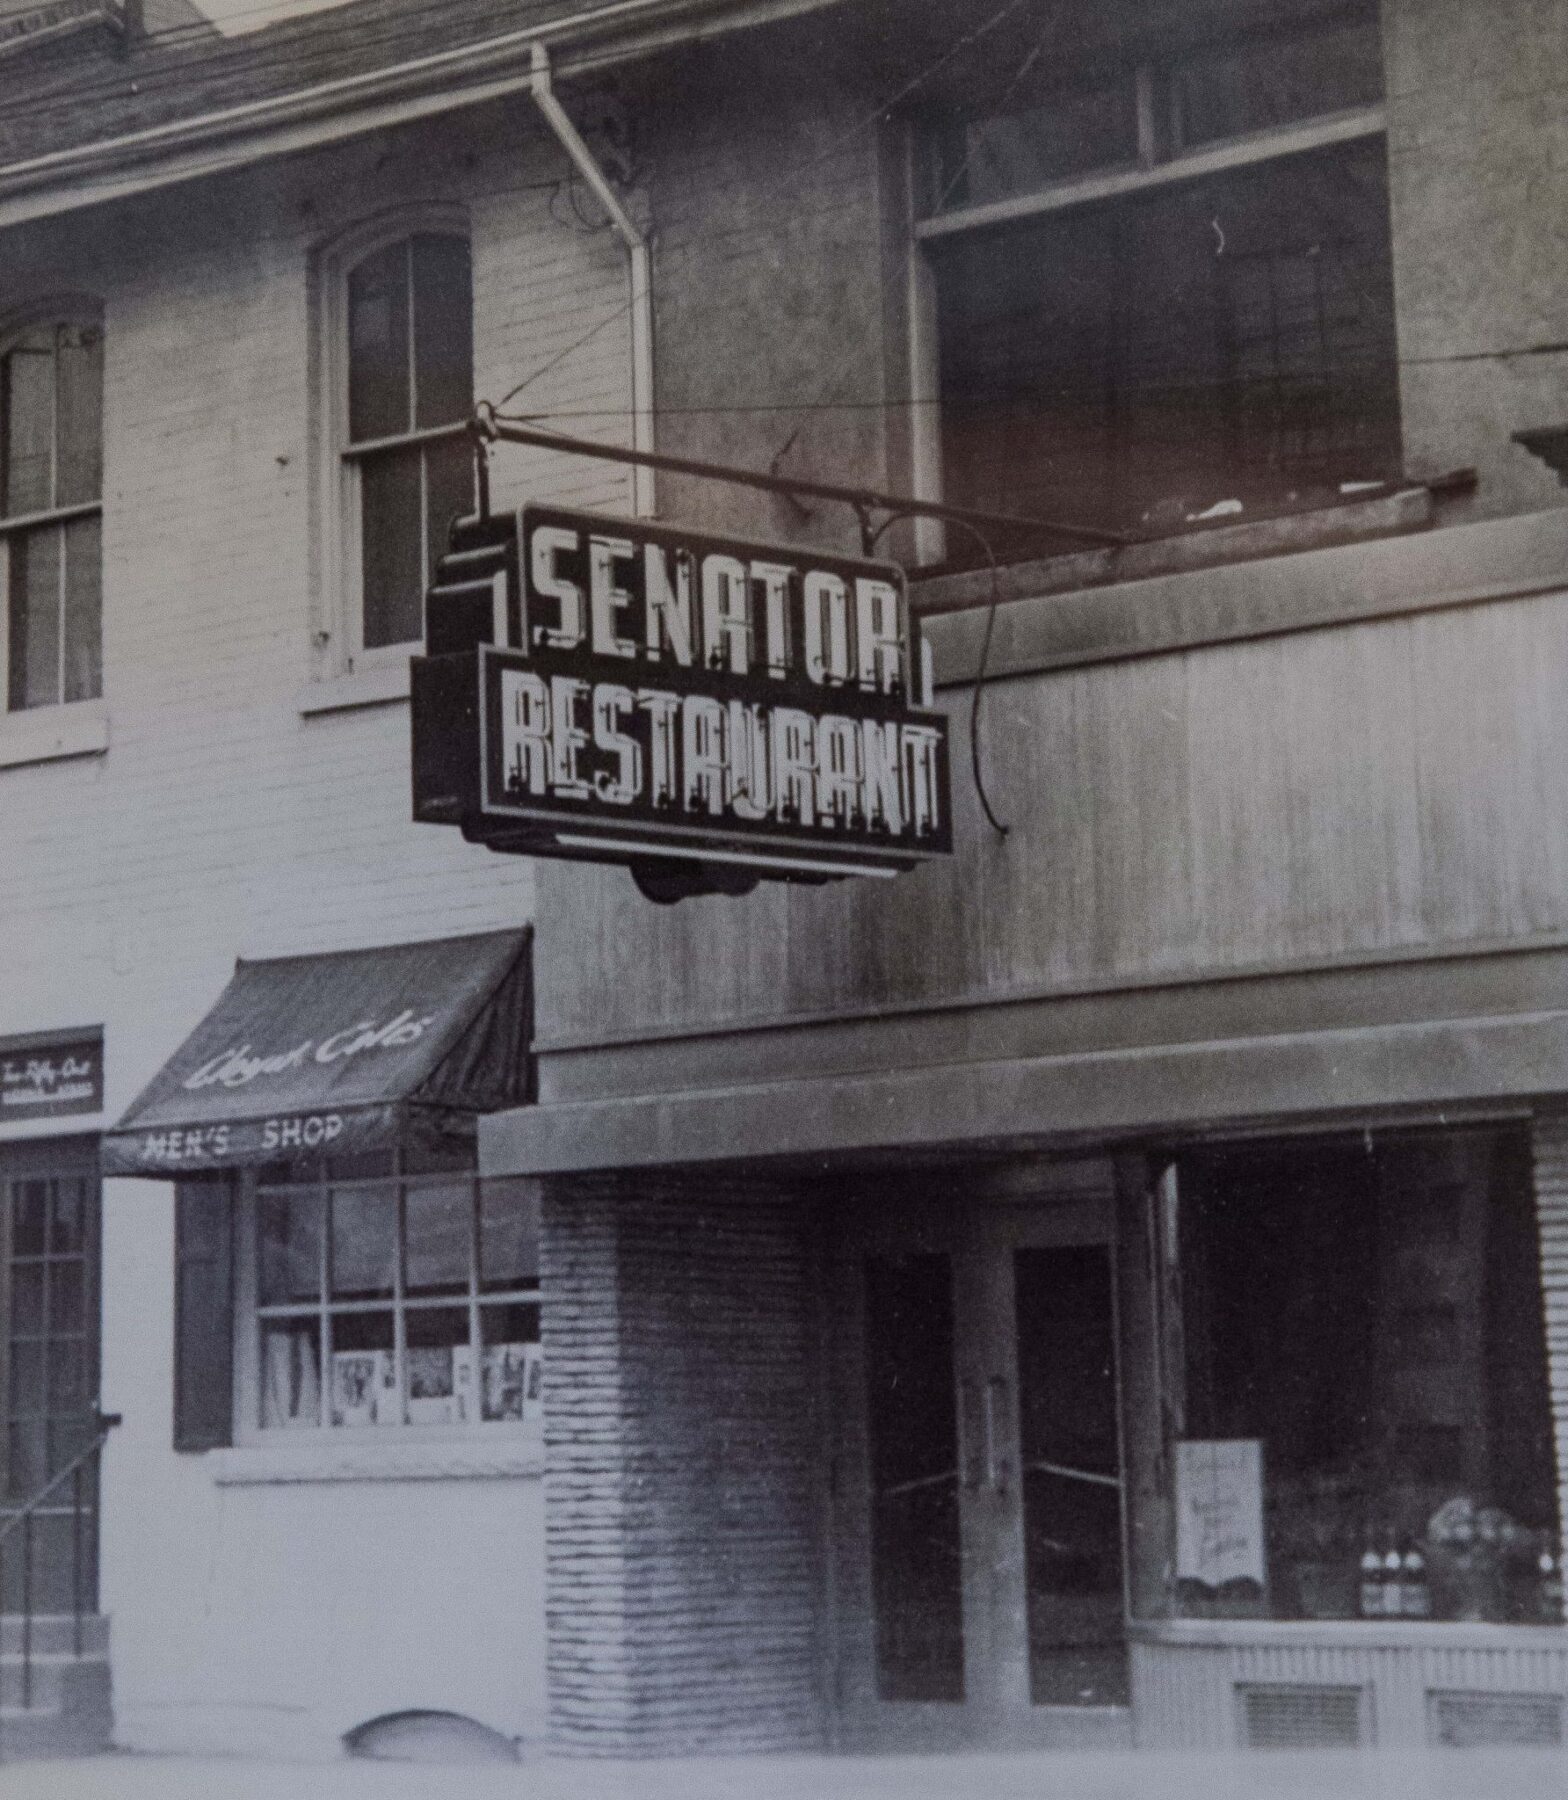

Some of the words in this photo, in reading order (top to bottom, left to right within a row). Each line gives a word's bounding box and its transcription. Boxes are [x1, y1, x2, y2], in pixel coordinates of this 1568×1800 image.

[531, 526, 902, 694] SENATOR
[501, 669, 942, 837] RESTAURANT
[142, 1125, 231, 1161] MEN'S
[261, 1114, 344, 1150] SHOP
